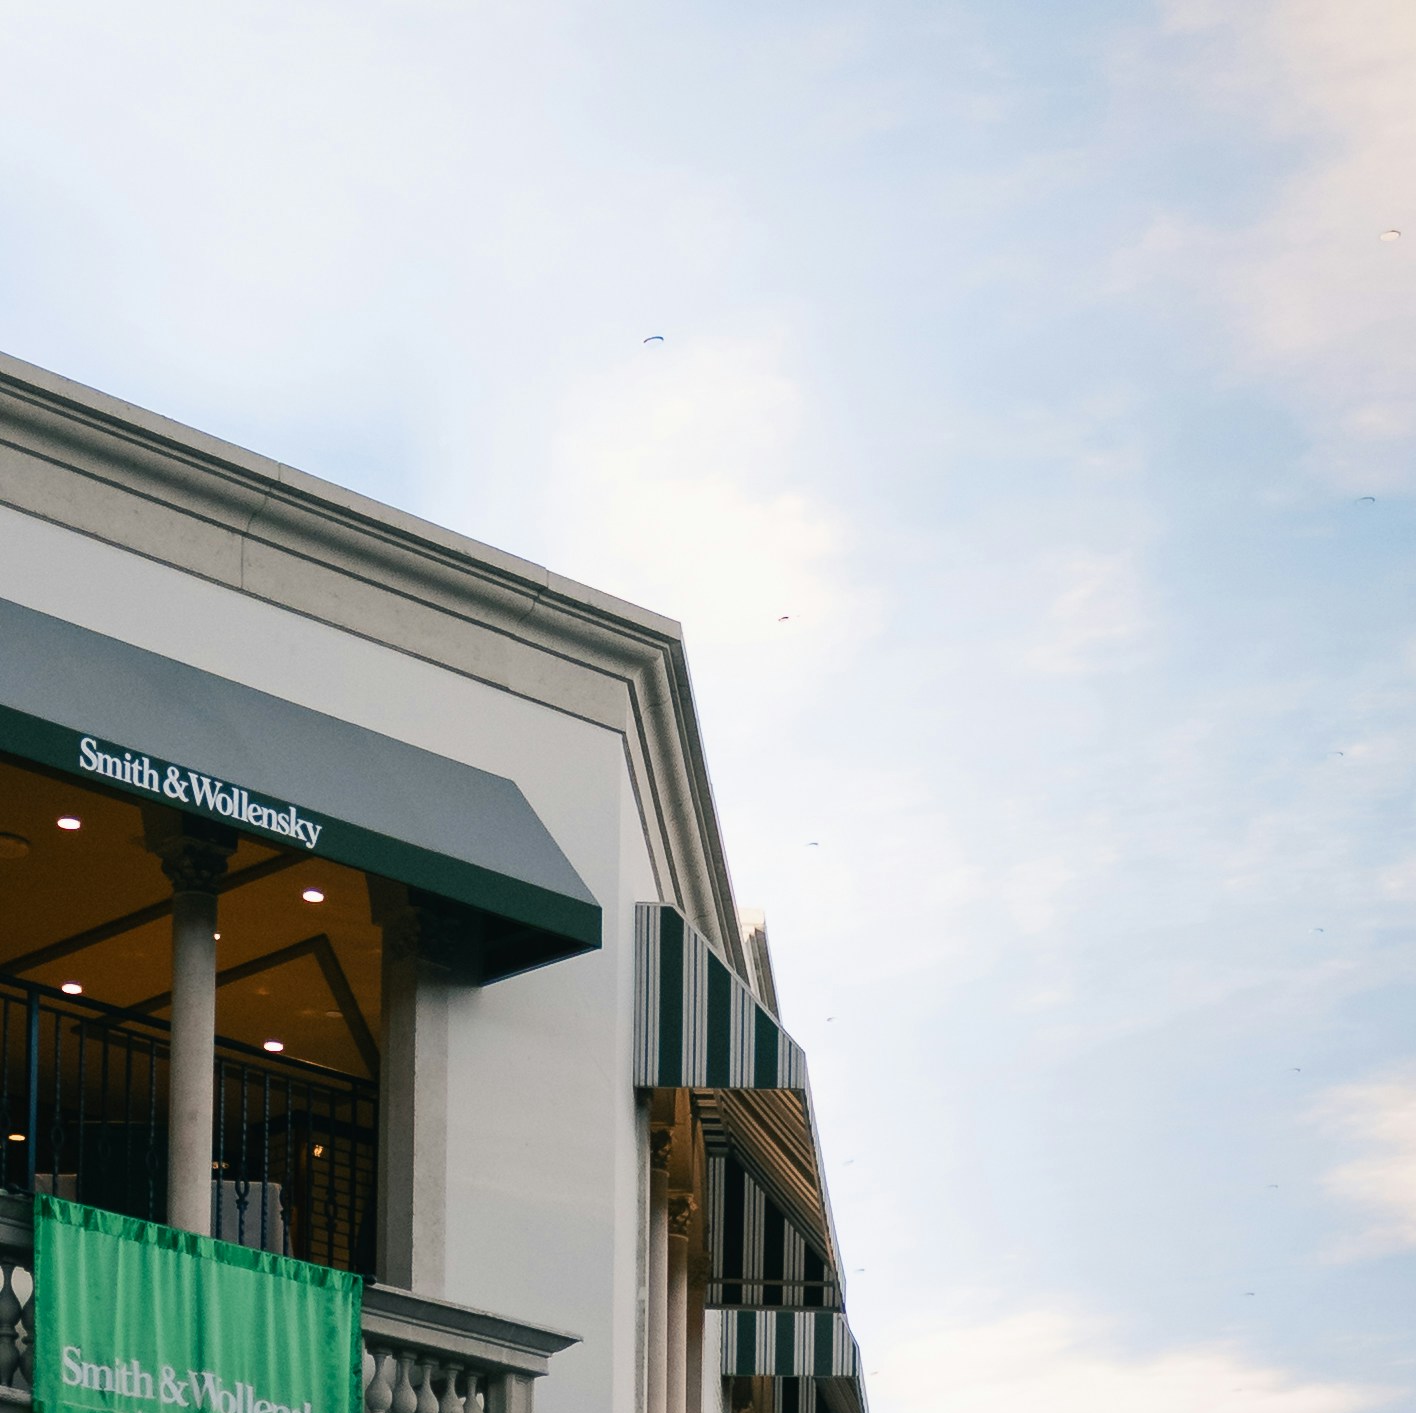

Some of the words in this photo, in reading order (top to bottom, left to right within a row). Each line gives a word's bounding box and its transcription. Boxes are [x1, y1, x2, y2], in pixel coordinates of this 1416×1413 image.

[79, 737, 160, 793] Smith
[163, 766, 189, 803] &
[188, 771, 323, 849] Wollensky
[61, 1345, 155, 1400] Smith
[159, 1365, 190, 1407] &
